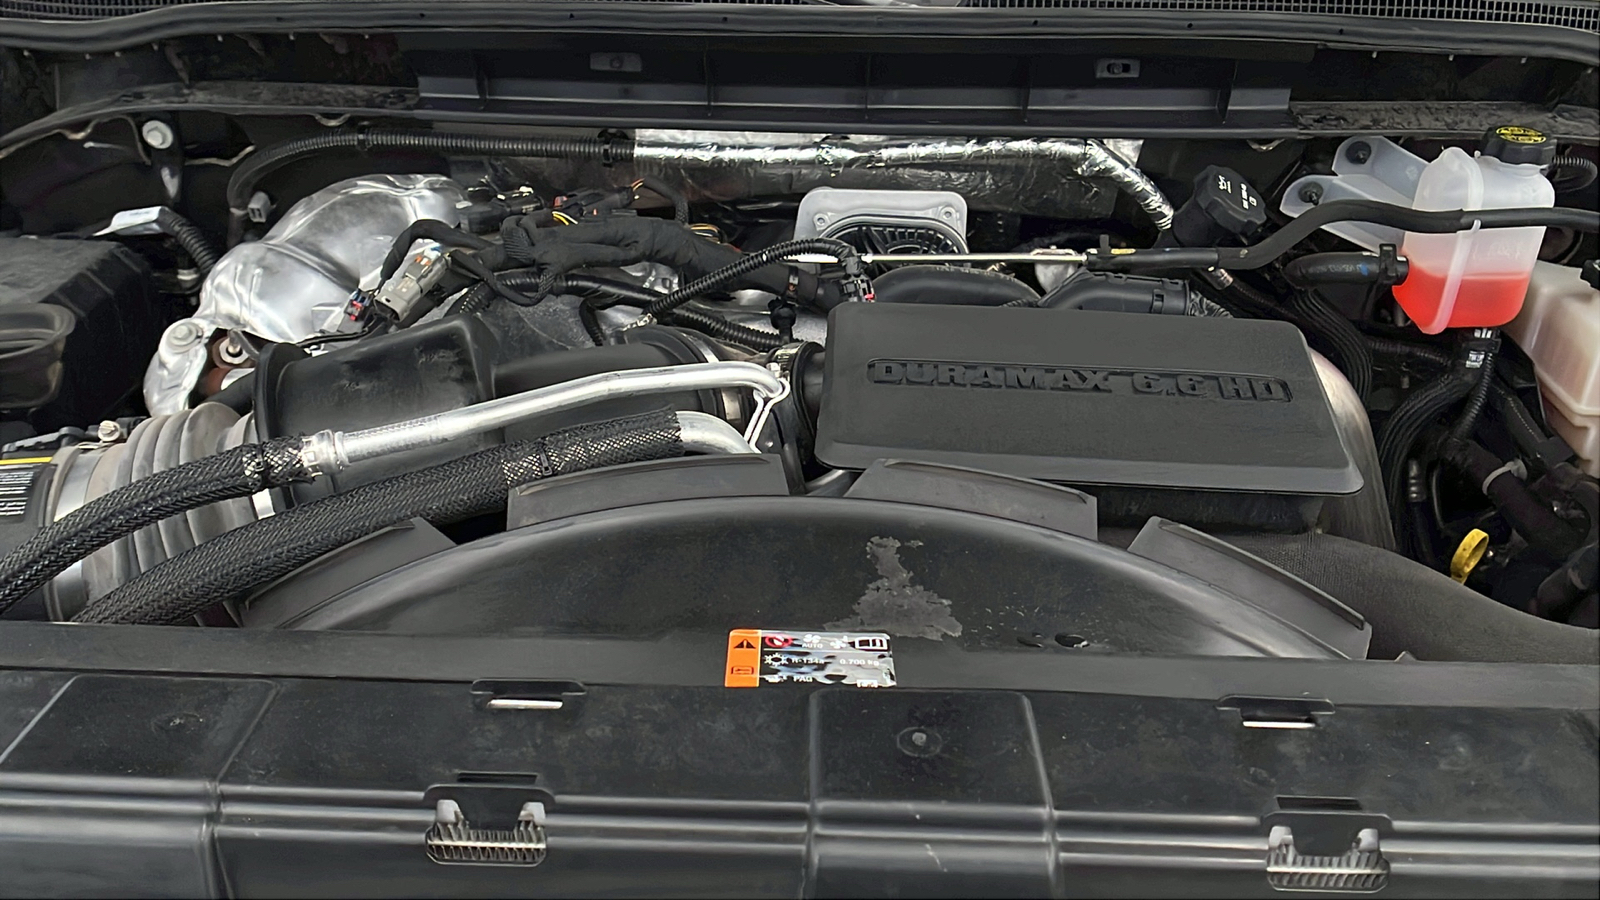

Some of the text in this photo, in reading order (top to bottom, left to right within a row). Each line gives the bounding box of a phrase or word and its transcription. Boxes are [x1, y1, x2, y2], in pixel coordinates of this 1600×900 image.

[873, 361, 1290, 402] DURAMAX 6.6 HD
